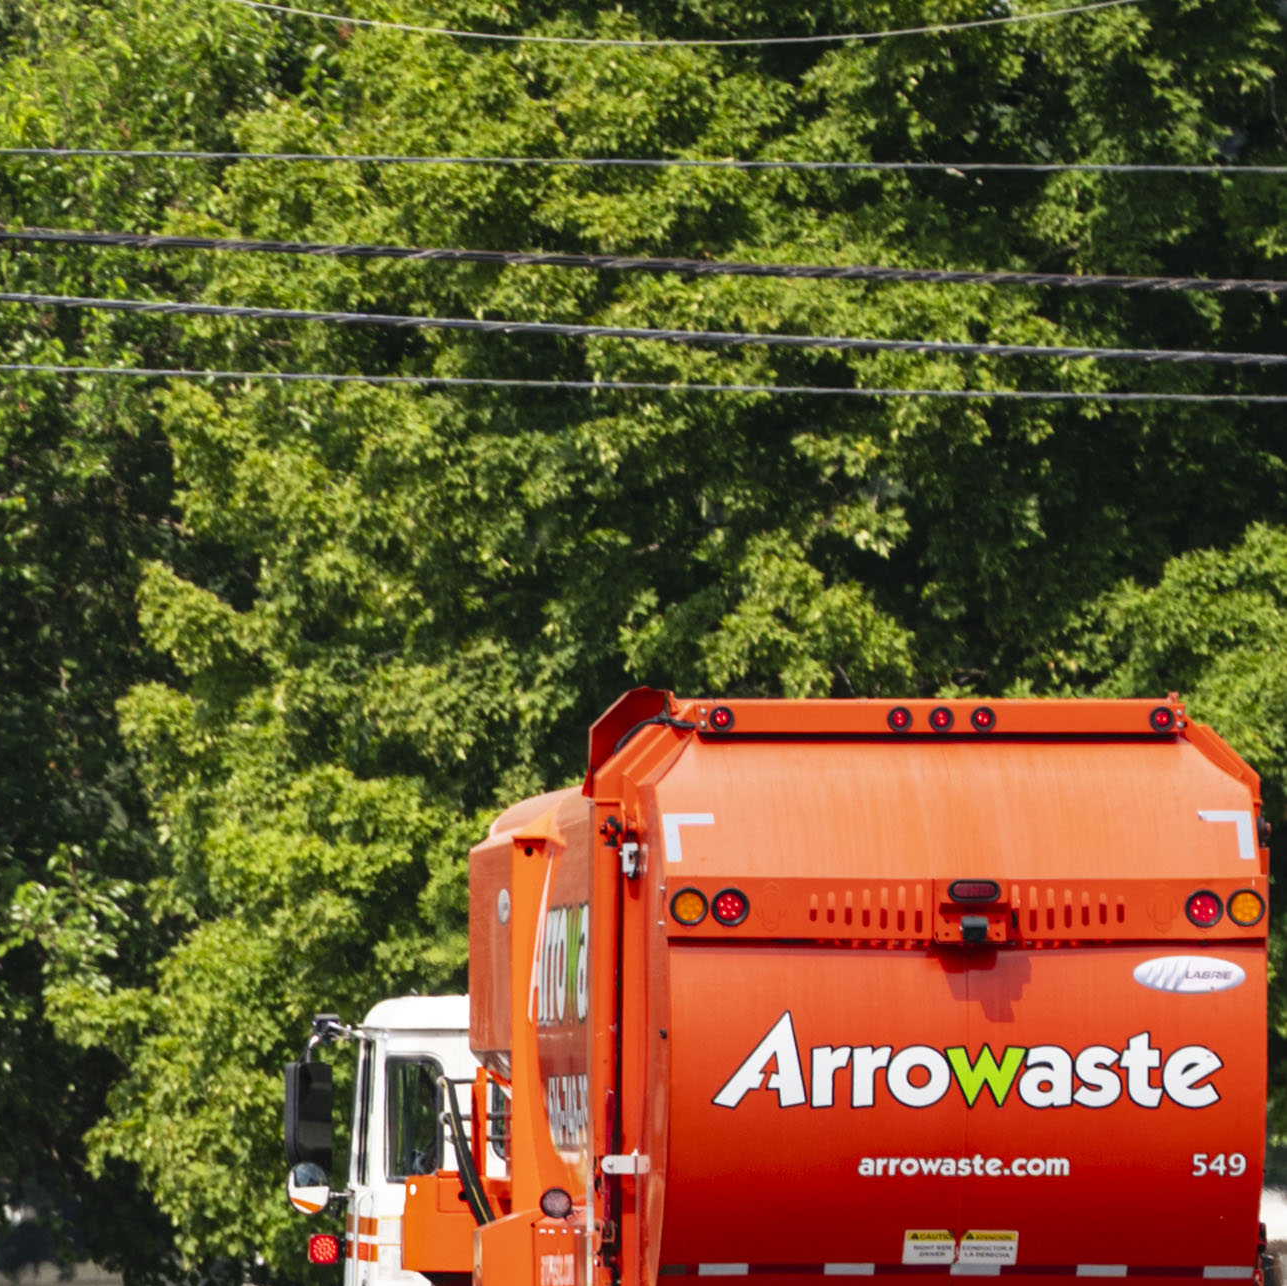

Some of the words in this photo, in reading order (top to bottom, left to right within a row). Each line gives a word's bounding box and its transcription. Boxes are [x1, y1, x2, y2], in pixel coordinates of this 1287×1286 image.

[1184, 970, 1233, 980] LABRIE
[713, 1009, 1223, 1109] Arrowaste
[857, 1153, 1071, 1178] arrowaste.com
[1190, 1153, 1248, 1178] 549
